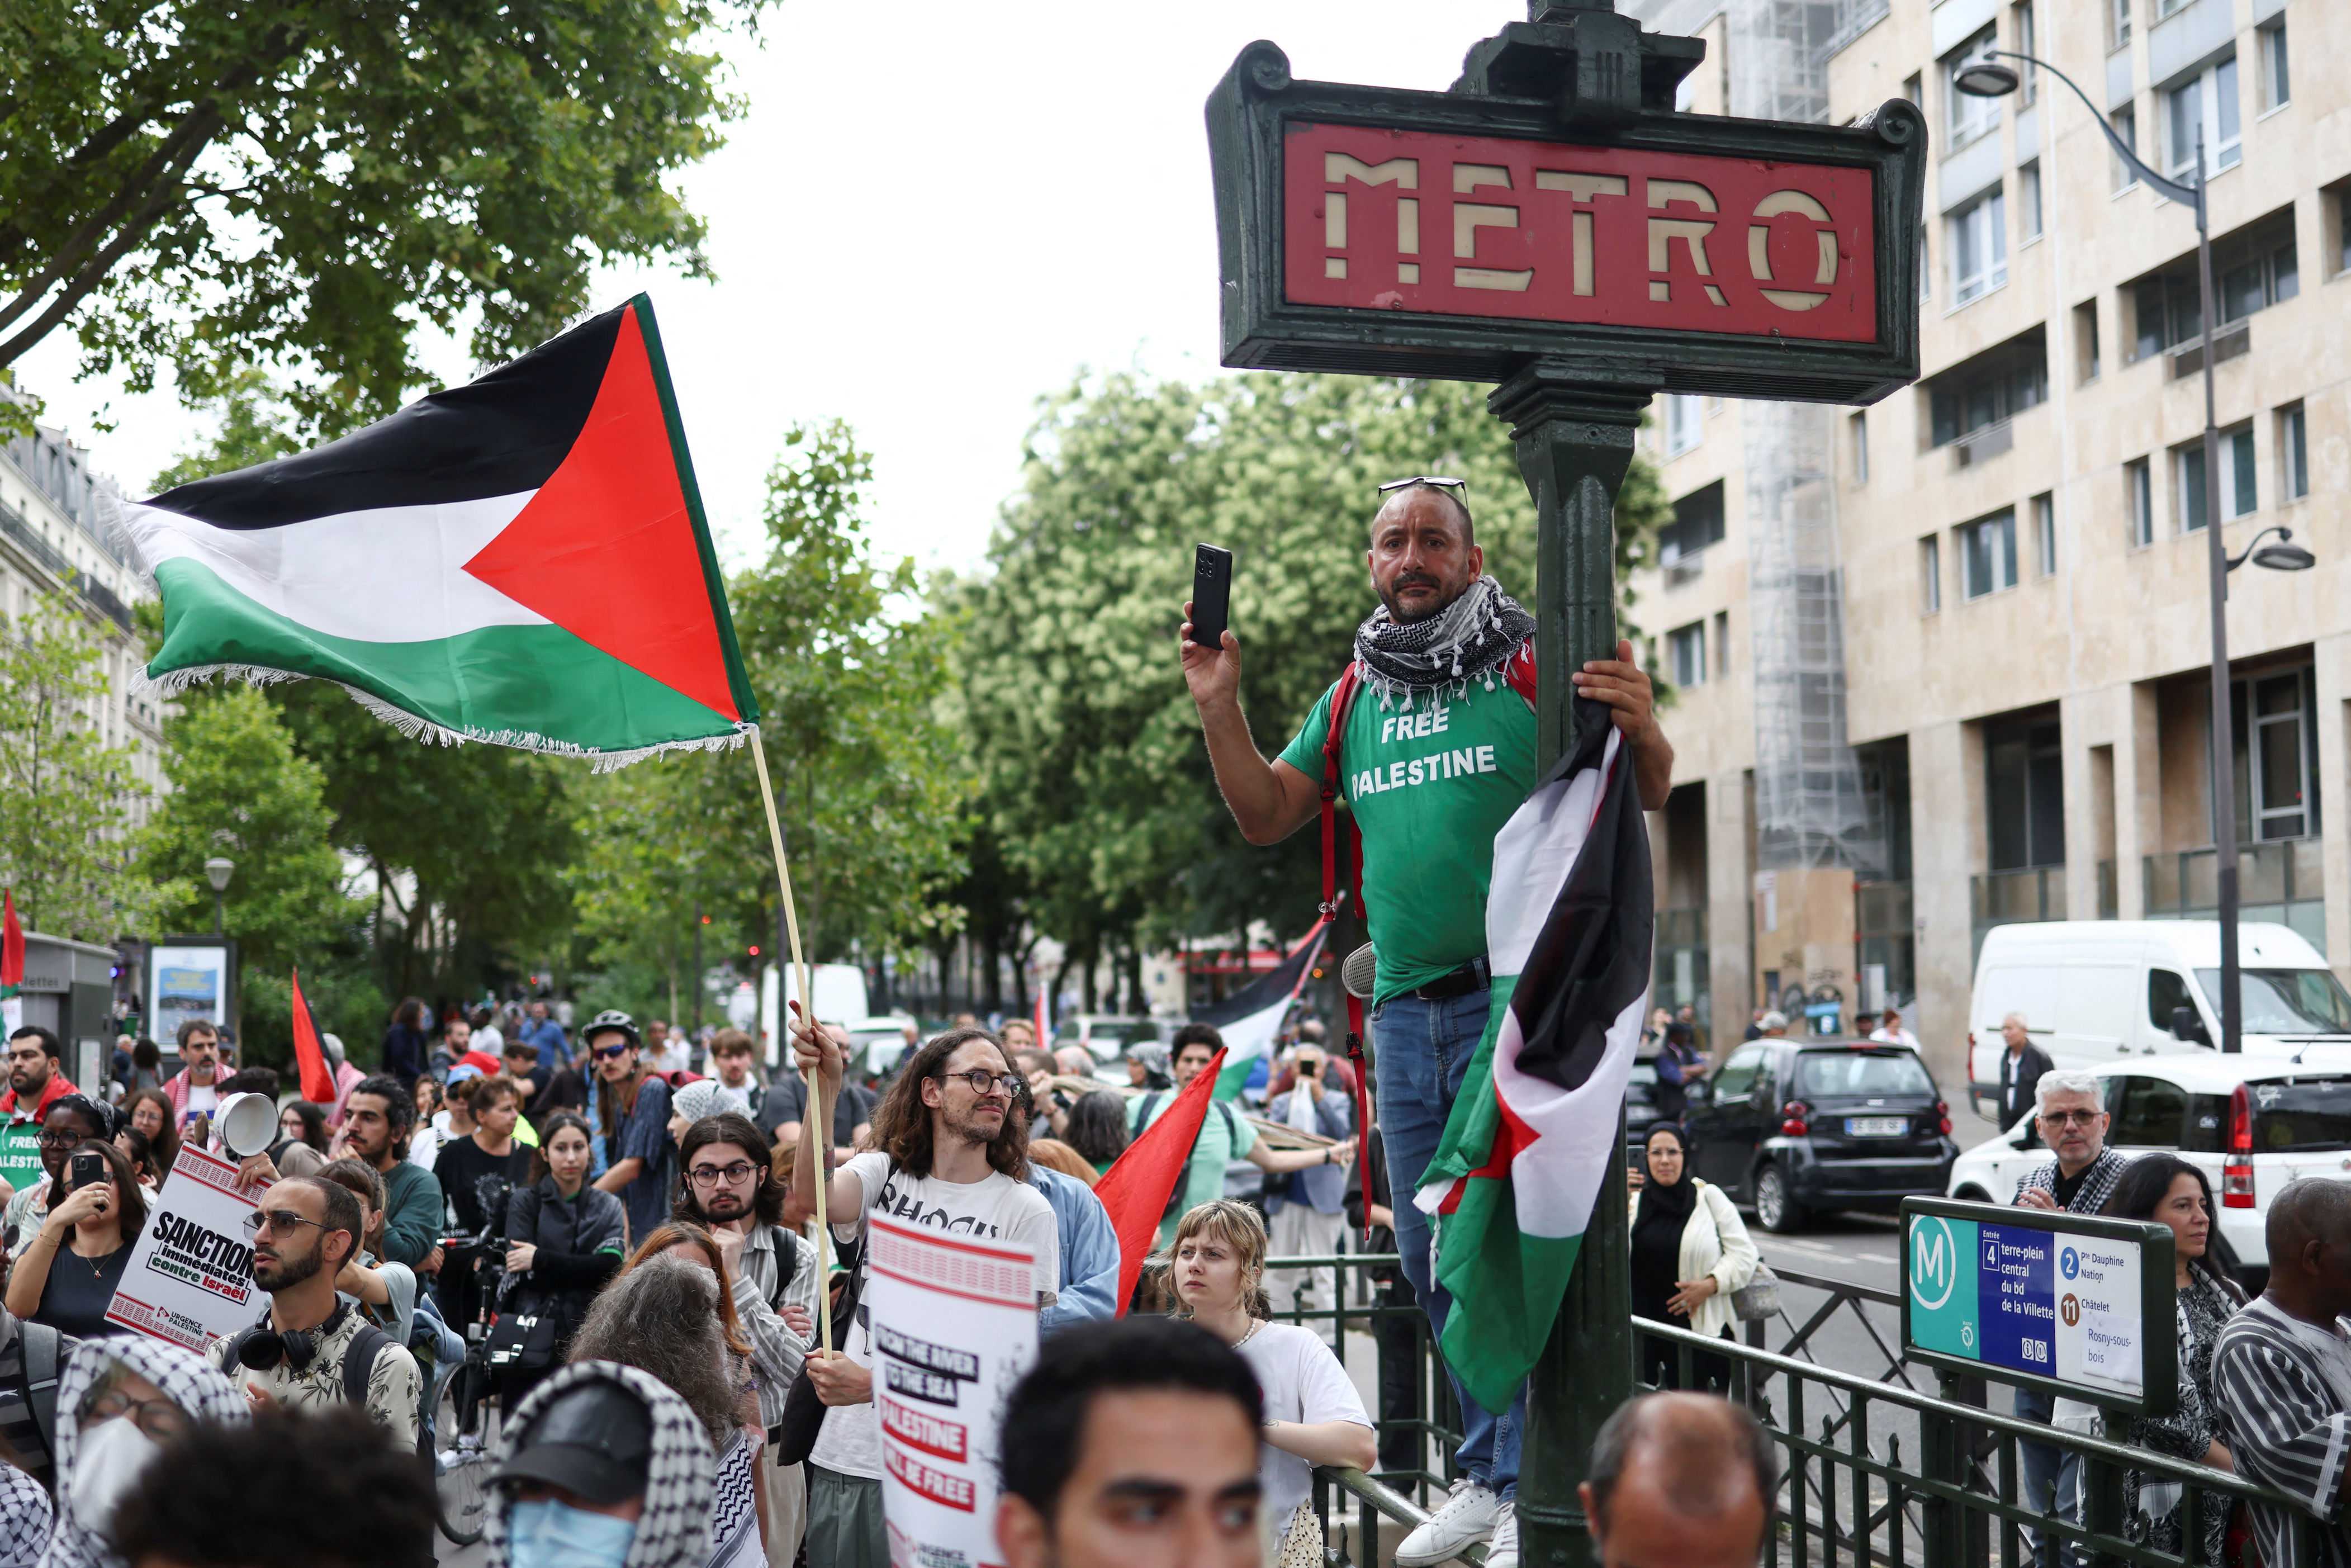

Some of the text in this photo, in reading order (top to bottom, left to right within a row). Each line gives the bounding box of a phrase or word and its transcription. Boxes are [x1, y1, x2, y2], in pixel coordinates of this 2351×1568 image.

[1325, 152, 1838, 311] METRO
[1381, 707, 1449, 743] FREE
[1352, 745, 1496, 801] PALESTINE
[1983, 1230, 1999, 1239] Entrée
[153, 1211, 255, 1280] SANCTION
[1987, 1245, 1995, 1264] 4
[2001, 1243, 2044, 1261] terre-plein
[162, 1245, 245, 1287] immédiates
[1917, 1231, 1944, 1288] M
[2065, 1253, 2074, 1274] 2
[2092, 1254, 2124, 1267] Dauphine
[152, 1257, 246, 1301] contre Israël
[2001, 1263, 2029, 1277] central
[2081, 1269, 2103, 1281] Nation
[2001, 1280, 2024, 1295] du bd
[2002, 1299, 2054, 1320] de la Villette
[2063, 1300, 2076, 1321] 11
[2081, 1299, 2110, 1313] Châtelet
[169, 1317, 203, 1336] PALESTINE
[171, 1311, 202, 1329] URGENCE
[2088, 1328, 2131, 1347] Rosny-sous-
[2088, 1349, 2104, 1363] bois
[880, 1396, 963, 1453] PALESTINE
[924, 1468, 970, 1504] FREE
